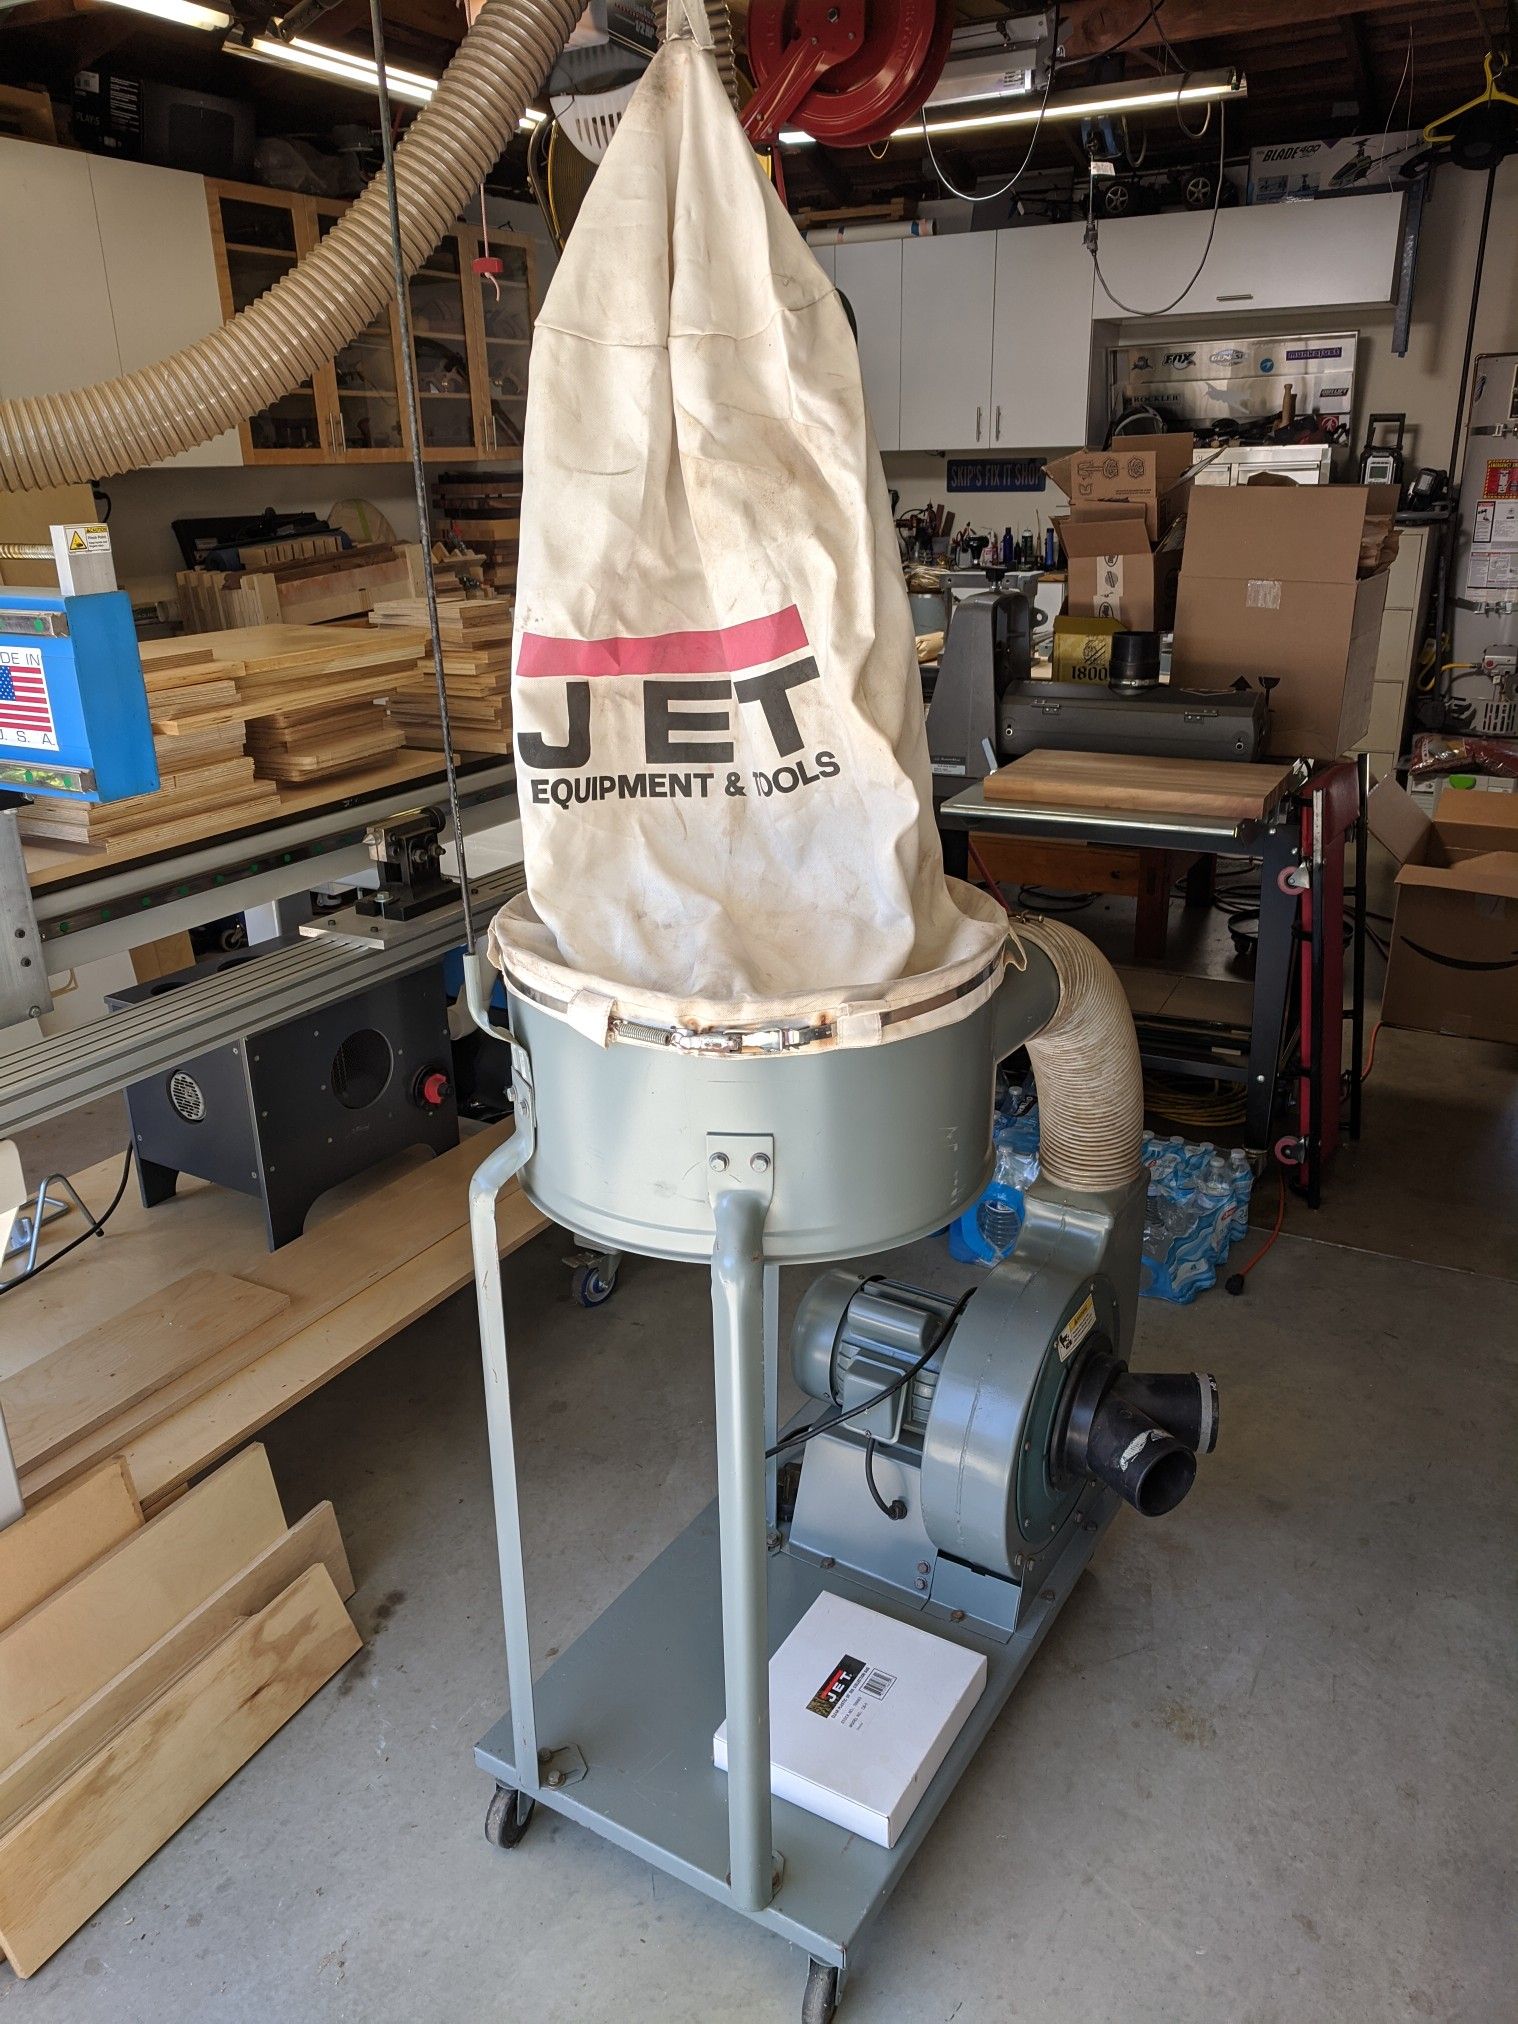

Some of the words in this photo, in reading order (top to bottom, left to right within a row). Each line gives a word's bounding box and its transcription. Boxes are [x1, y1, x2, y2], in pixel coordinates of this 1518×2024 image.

[1262, 147, 1301, 162] BLADE
[1162, 352, 1196, 366] FOX
[951, 466, 982, 488] SKIP'S
[985, 465, 1000, 486] FIX
[1003, 465, 1013, 486] IT
[25, 653, 40, 666] IN
[1071, 665, 1108, 681] 1800
[517, 655, 821, 770] JET
[530, 772, 715, 810] EQUIPMENT
[724, 771, 747, 798] &
[752, 751, 841, 798] TOOLS
[827, 1671, 852, 1703] JET
